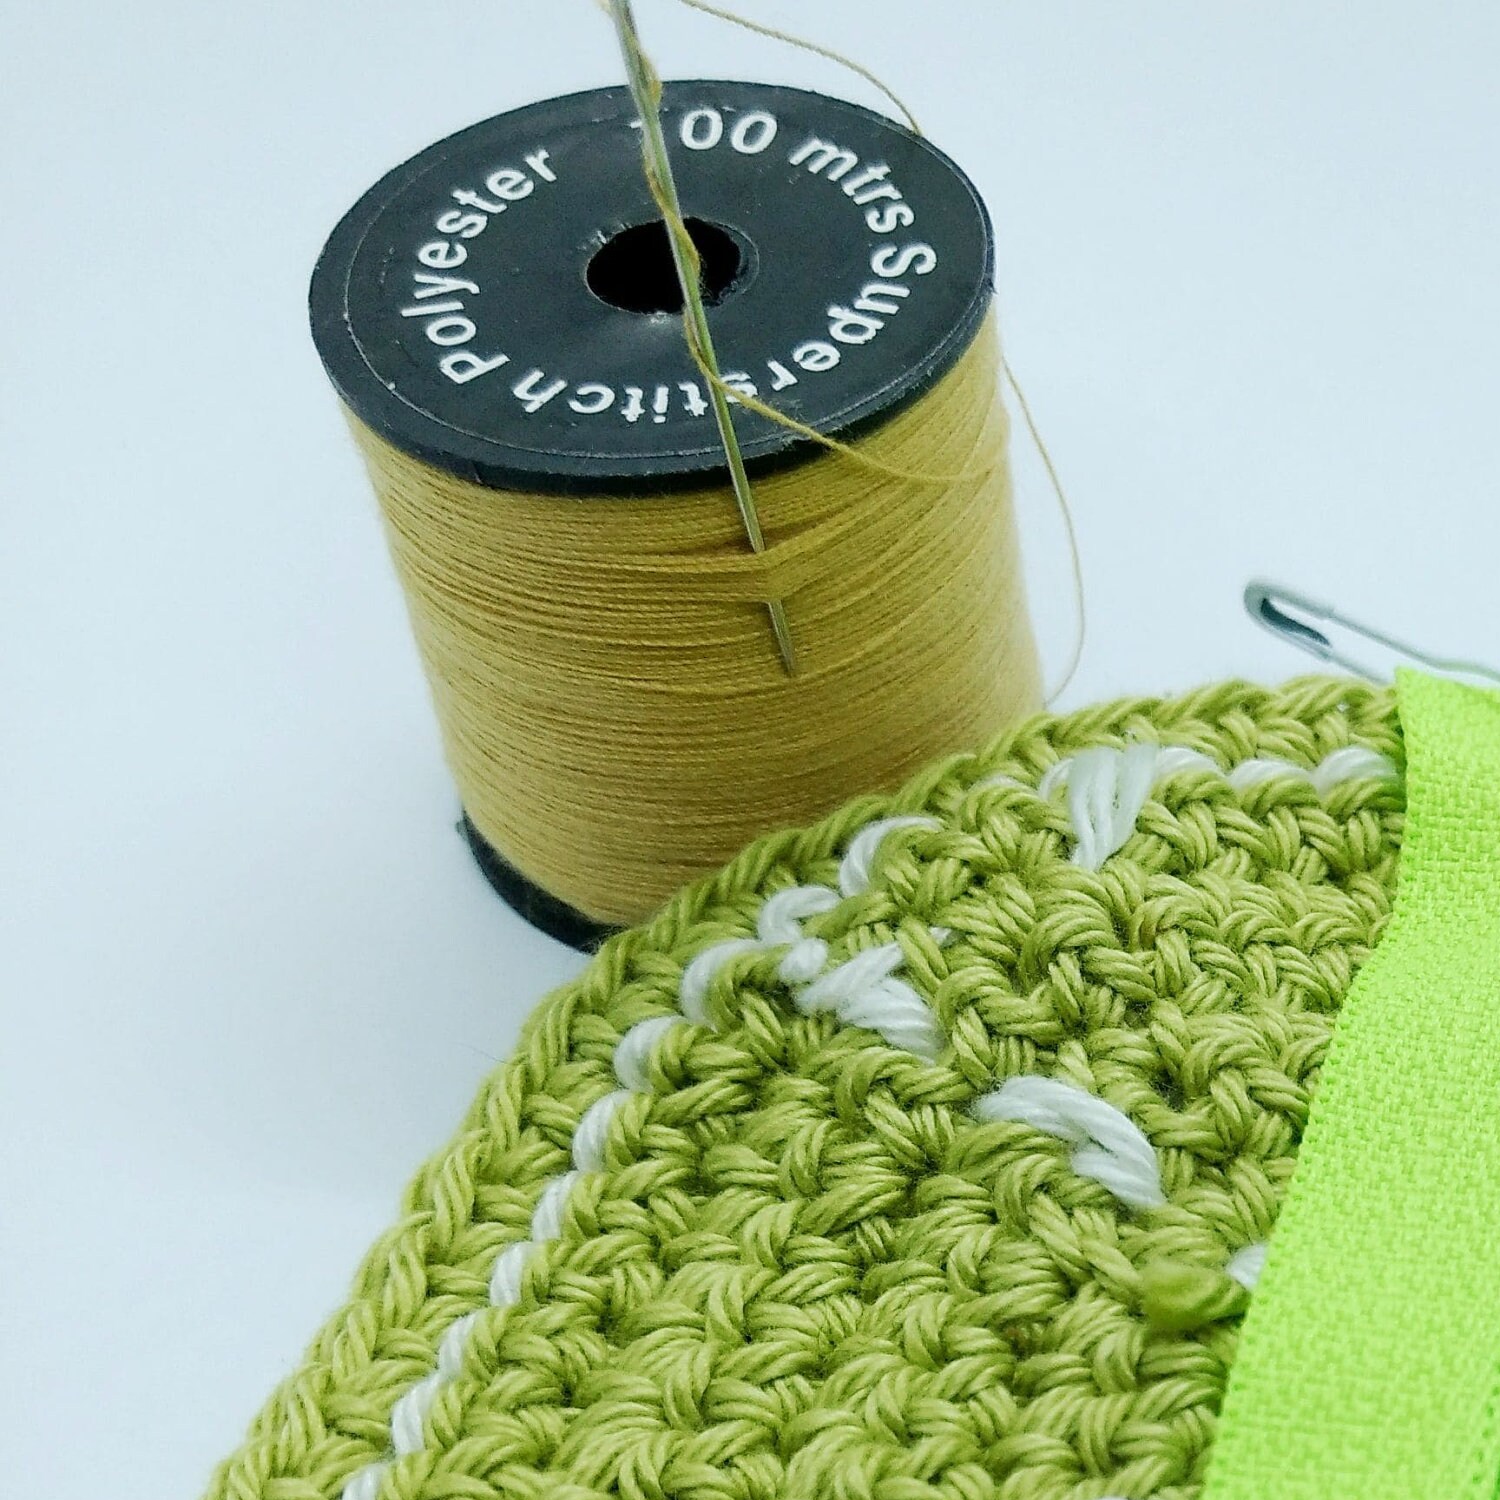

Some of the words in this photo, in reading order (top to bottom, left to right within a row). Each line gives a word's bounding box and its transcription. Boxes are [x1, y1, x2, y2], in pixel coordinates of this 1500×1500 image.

[629, 107, 778, 154] 00
[787, 135, 915, 233] mtrs
[400, 148, 557, 385] Polyester
